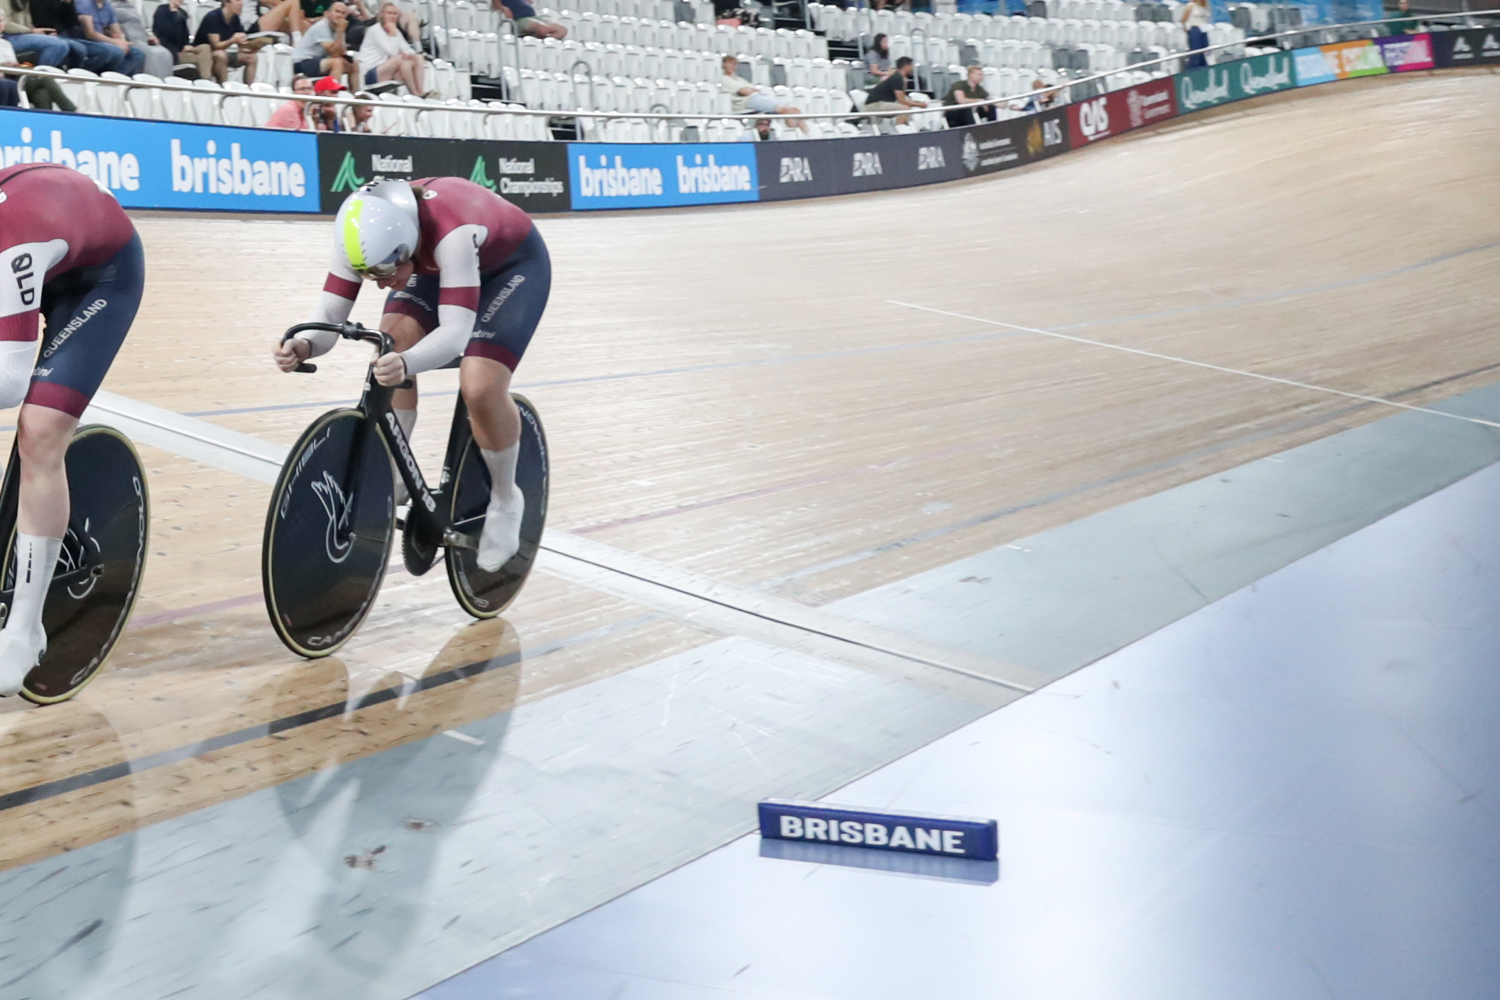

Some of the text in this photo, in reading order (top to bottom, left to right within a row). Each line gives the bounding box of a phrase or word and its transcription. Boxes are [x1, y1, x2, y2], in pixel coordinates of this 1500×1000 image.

[170, 138, 306, 198] brisbane
[371, 154, 413, 173] National
[498, 157, 536, 174] National
[578, 154, 663, 197] brisbane
[676, 153, 751, 194] brisbane
[500, 177, 565, 198] Championships
[11, 252, 35, 306] QLD
[481, 274, 526, 323] QUEENSLAND
[43, 298, 108, 358] QUEENSLAND
[384, 412, 437, 513] ARGON 18
[779, 815, 966, 854] BRISBANE
